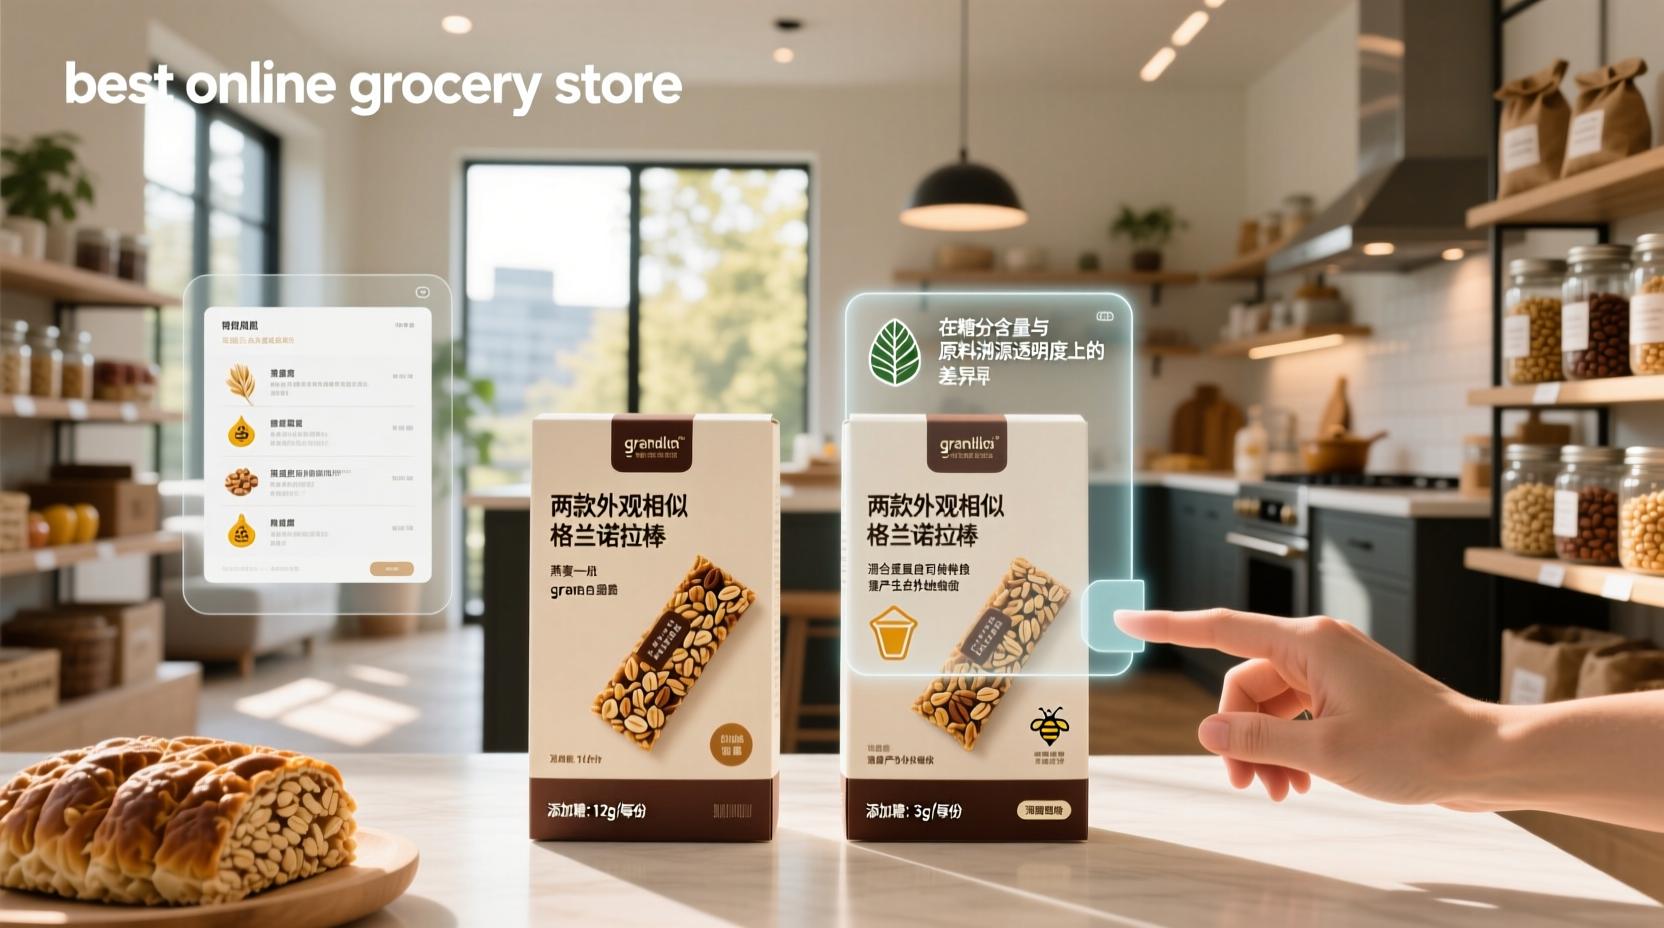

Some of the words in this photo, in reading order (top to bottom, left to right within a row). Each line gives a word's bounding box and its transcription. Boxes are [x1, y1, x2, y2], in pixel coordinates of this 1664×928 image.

[550, 493, 688, 518] 两款外观相似
[867, 493, 1005, 518] 两款外观相似
[550, 523, 667, 548] 格兰诺拉棒
[867, 522, 979, 547] 格兰诺拉棒
